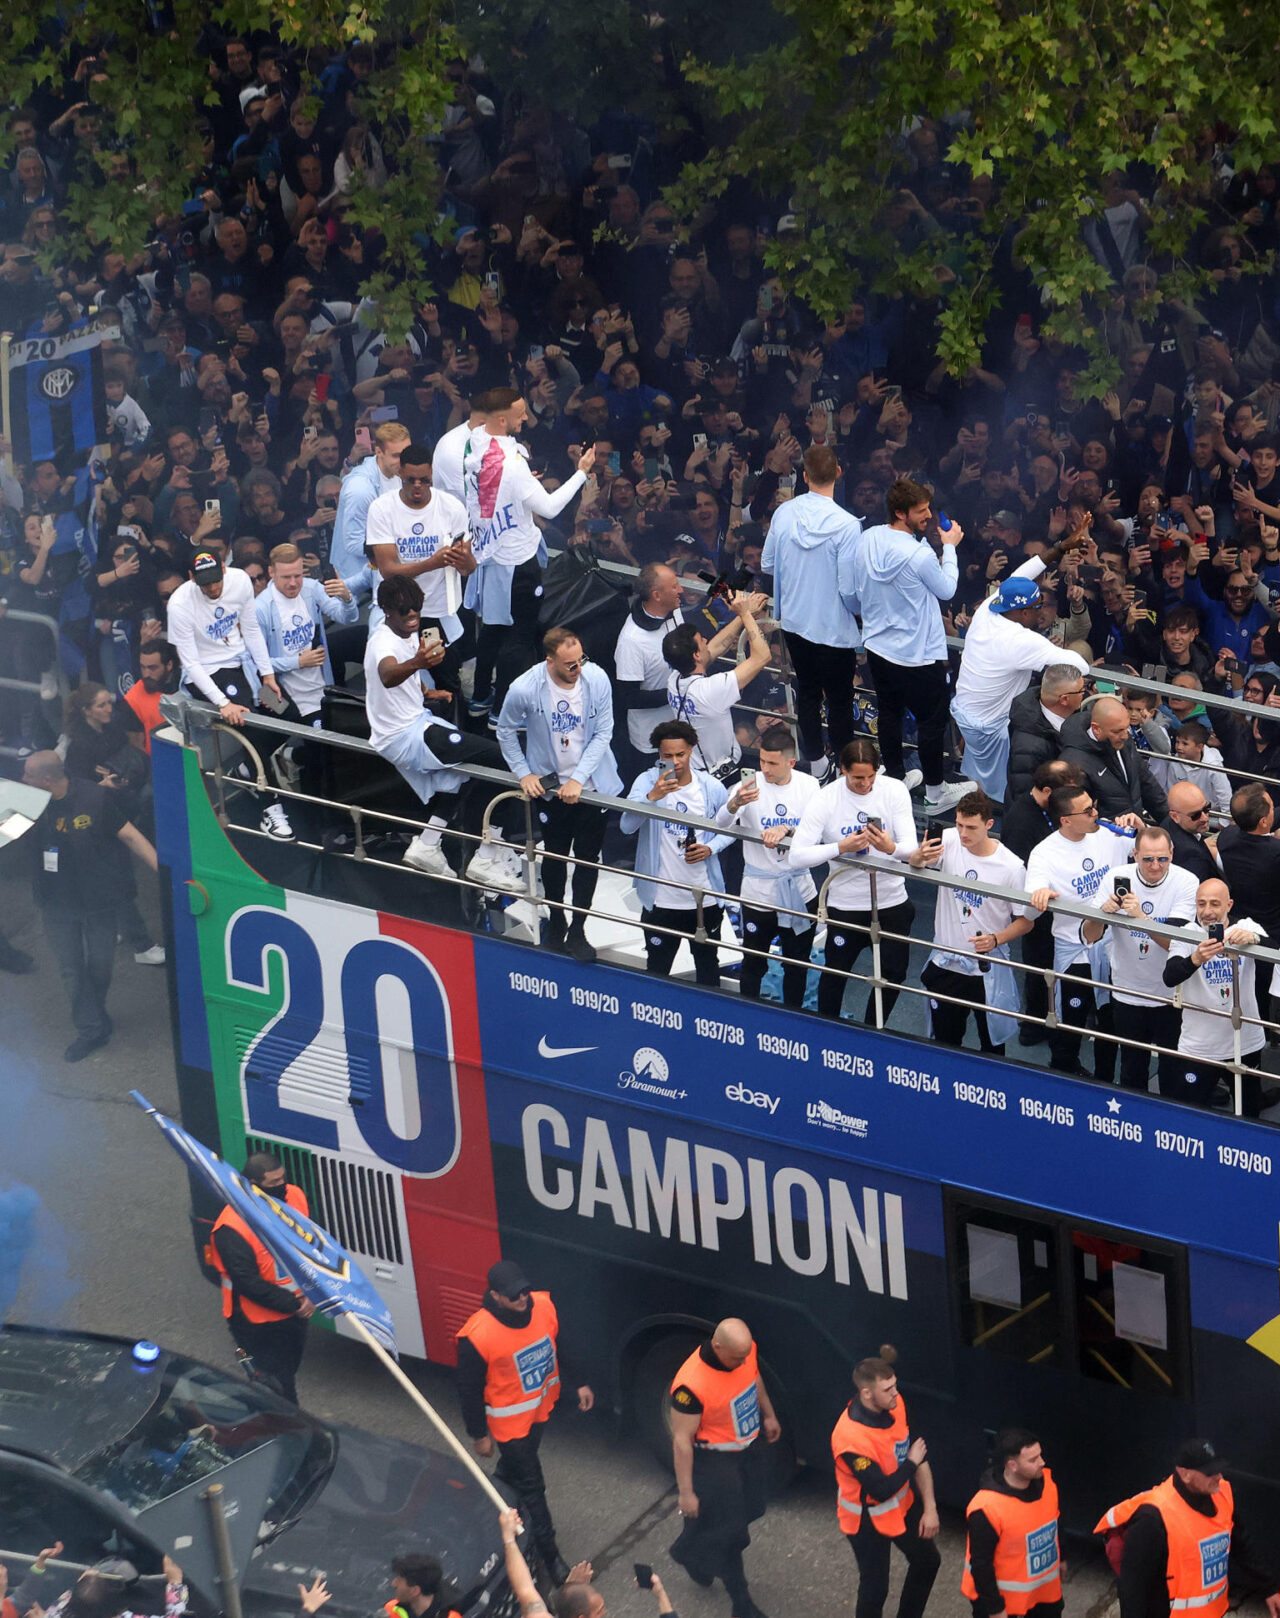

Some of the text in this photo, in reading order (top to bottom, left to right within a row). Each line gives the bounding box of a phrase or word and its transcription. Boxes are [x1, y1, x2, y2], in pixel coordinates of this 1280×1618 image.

[26, 339, 56, 361] 20
[396, 535, 439, 549] CAMPIONI
[1071, 864, 1110, 888] CAMPIONI
[509, 971, 559, 1000] 1909/10
[570, 987, 620, 1014] 1919/20
[631, 1002, 683, 1030] 1929/30
[224, 904, 462, 1181] 20
[694, 1018, 746, 1046] 1937/38
[757, 1033, 809, 1062] 1939/40
[821, 1048, 874, 1079] 1952/53
[617, 1070, 688, 1100] Paramount+
[885, 1064, 941, 1095] 1953/54
[725, 1082, 781, 1115] ebay
[952, 1081, 1007, 1110] 1962/63
[1019, 1097, 1075, 1127] 1964/65
[1086, 1113, 1142, 1144] 1965/66
[1154, 1129, 1205, 1160] 1970/71
[1216, 1145, 1272, 1176] 1979/80
[521, 1103, 909, 1301] CAMPIONI
